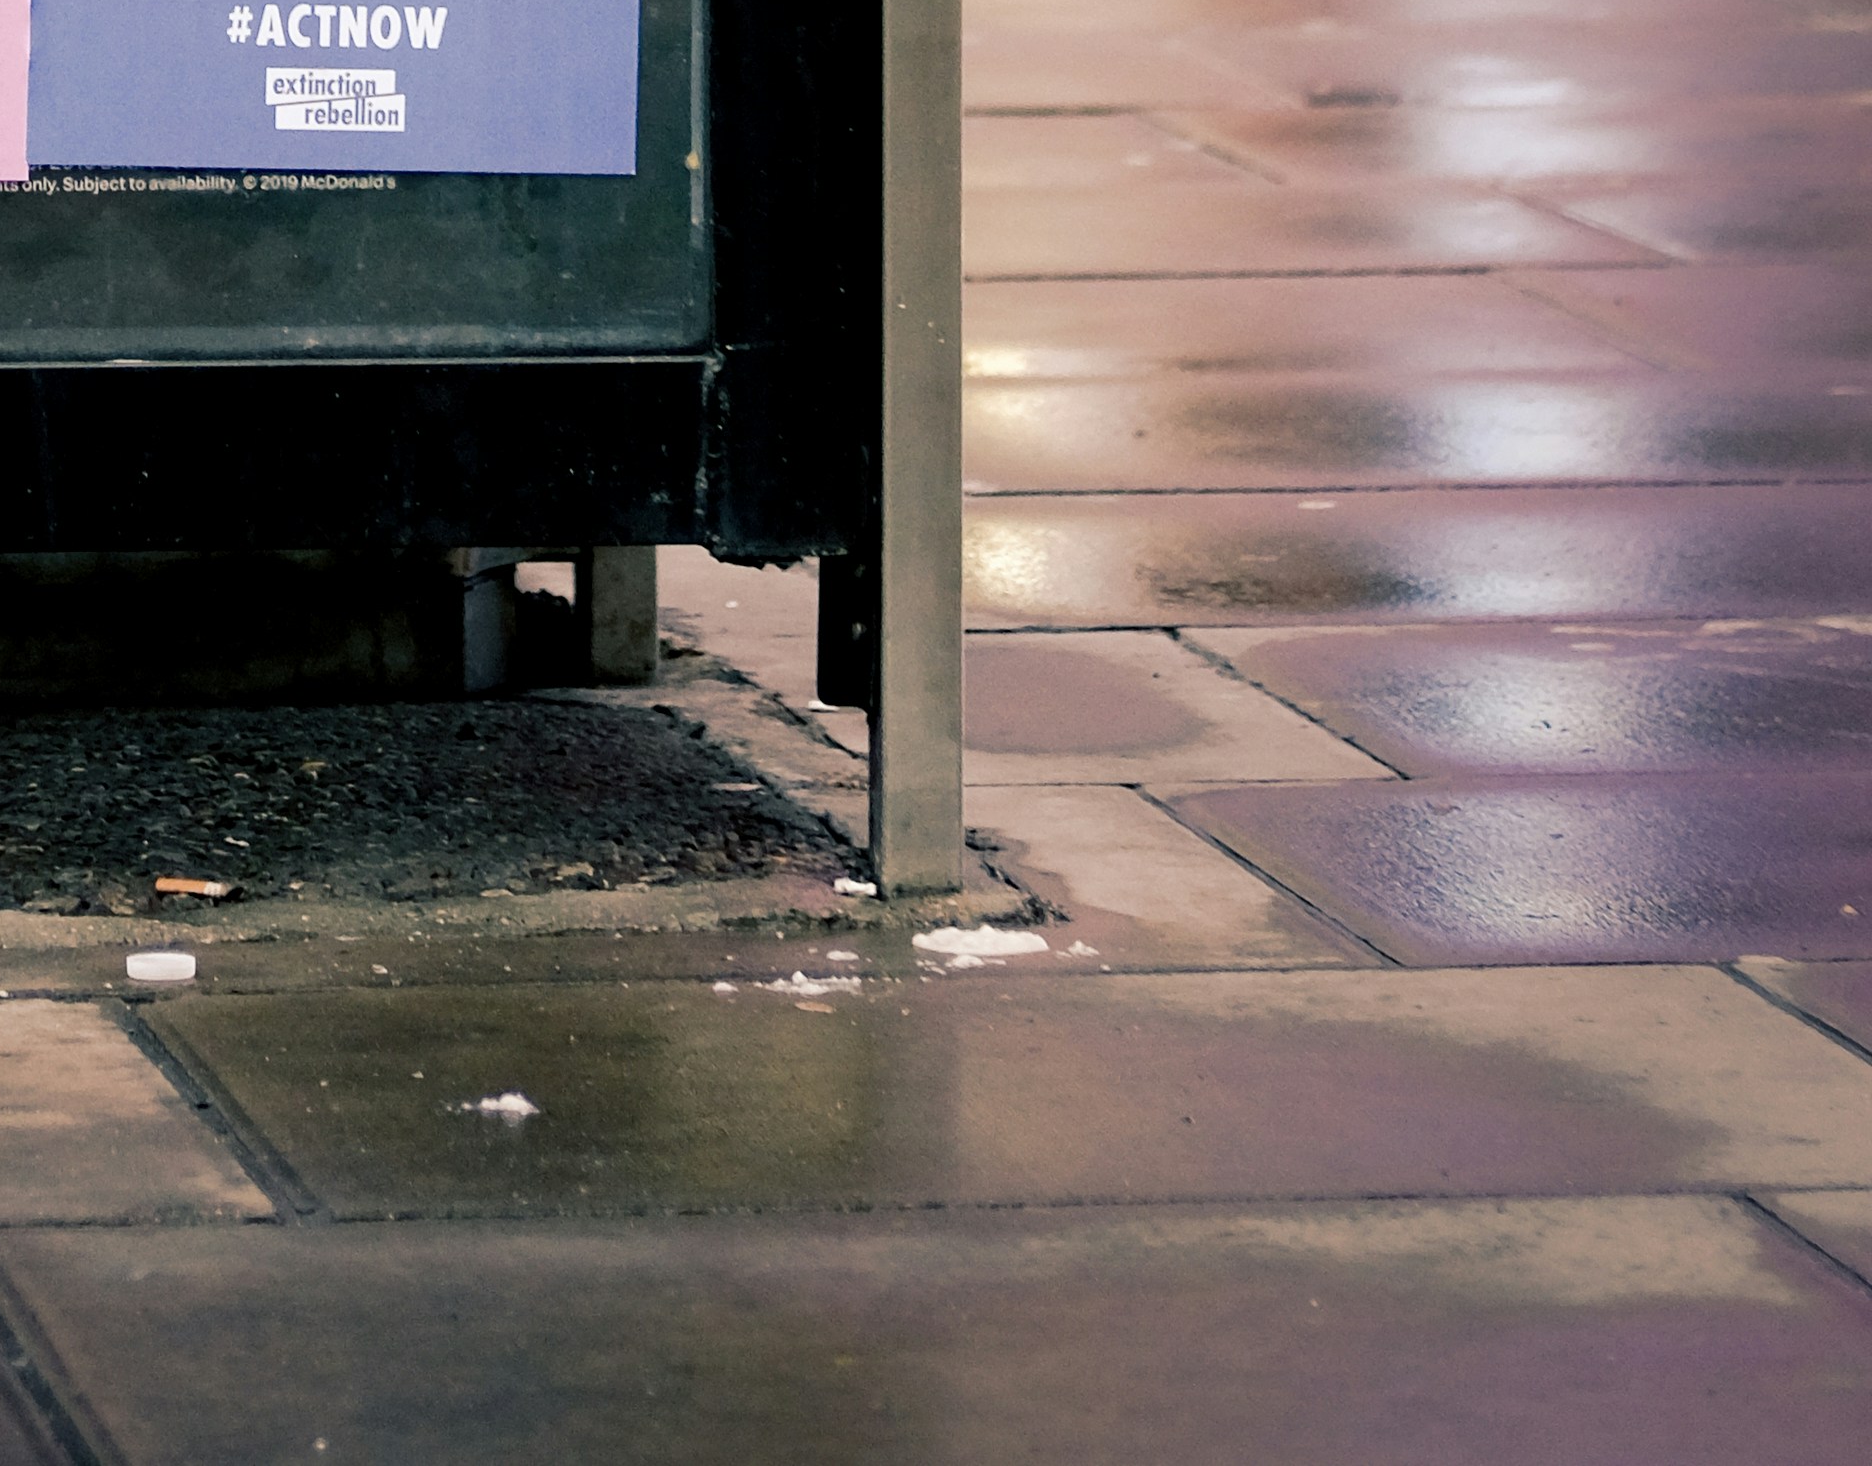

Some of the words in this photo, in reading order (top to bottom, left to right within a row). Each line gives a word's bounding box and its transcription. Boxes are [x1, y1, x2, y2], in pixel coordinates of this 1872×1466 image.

[226, 2, 448, 50] #ACTNOW
[272, 72, 378, 98] extinction
[303, 98, 400, 127] rebellion
[23, 176, 61, 196] only.
[62, 175, 127, 195] Subject
[129, 177, 146, 192] to
[259, 175, 299, 191] 2019
